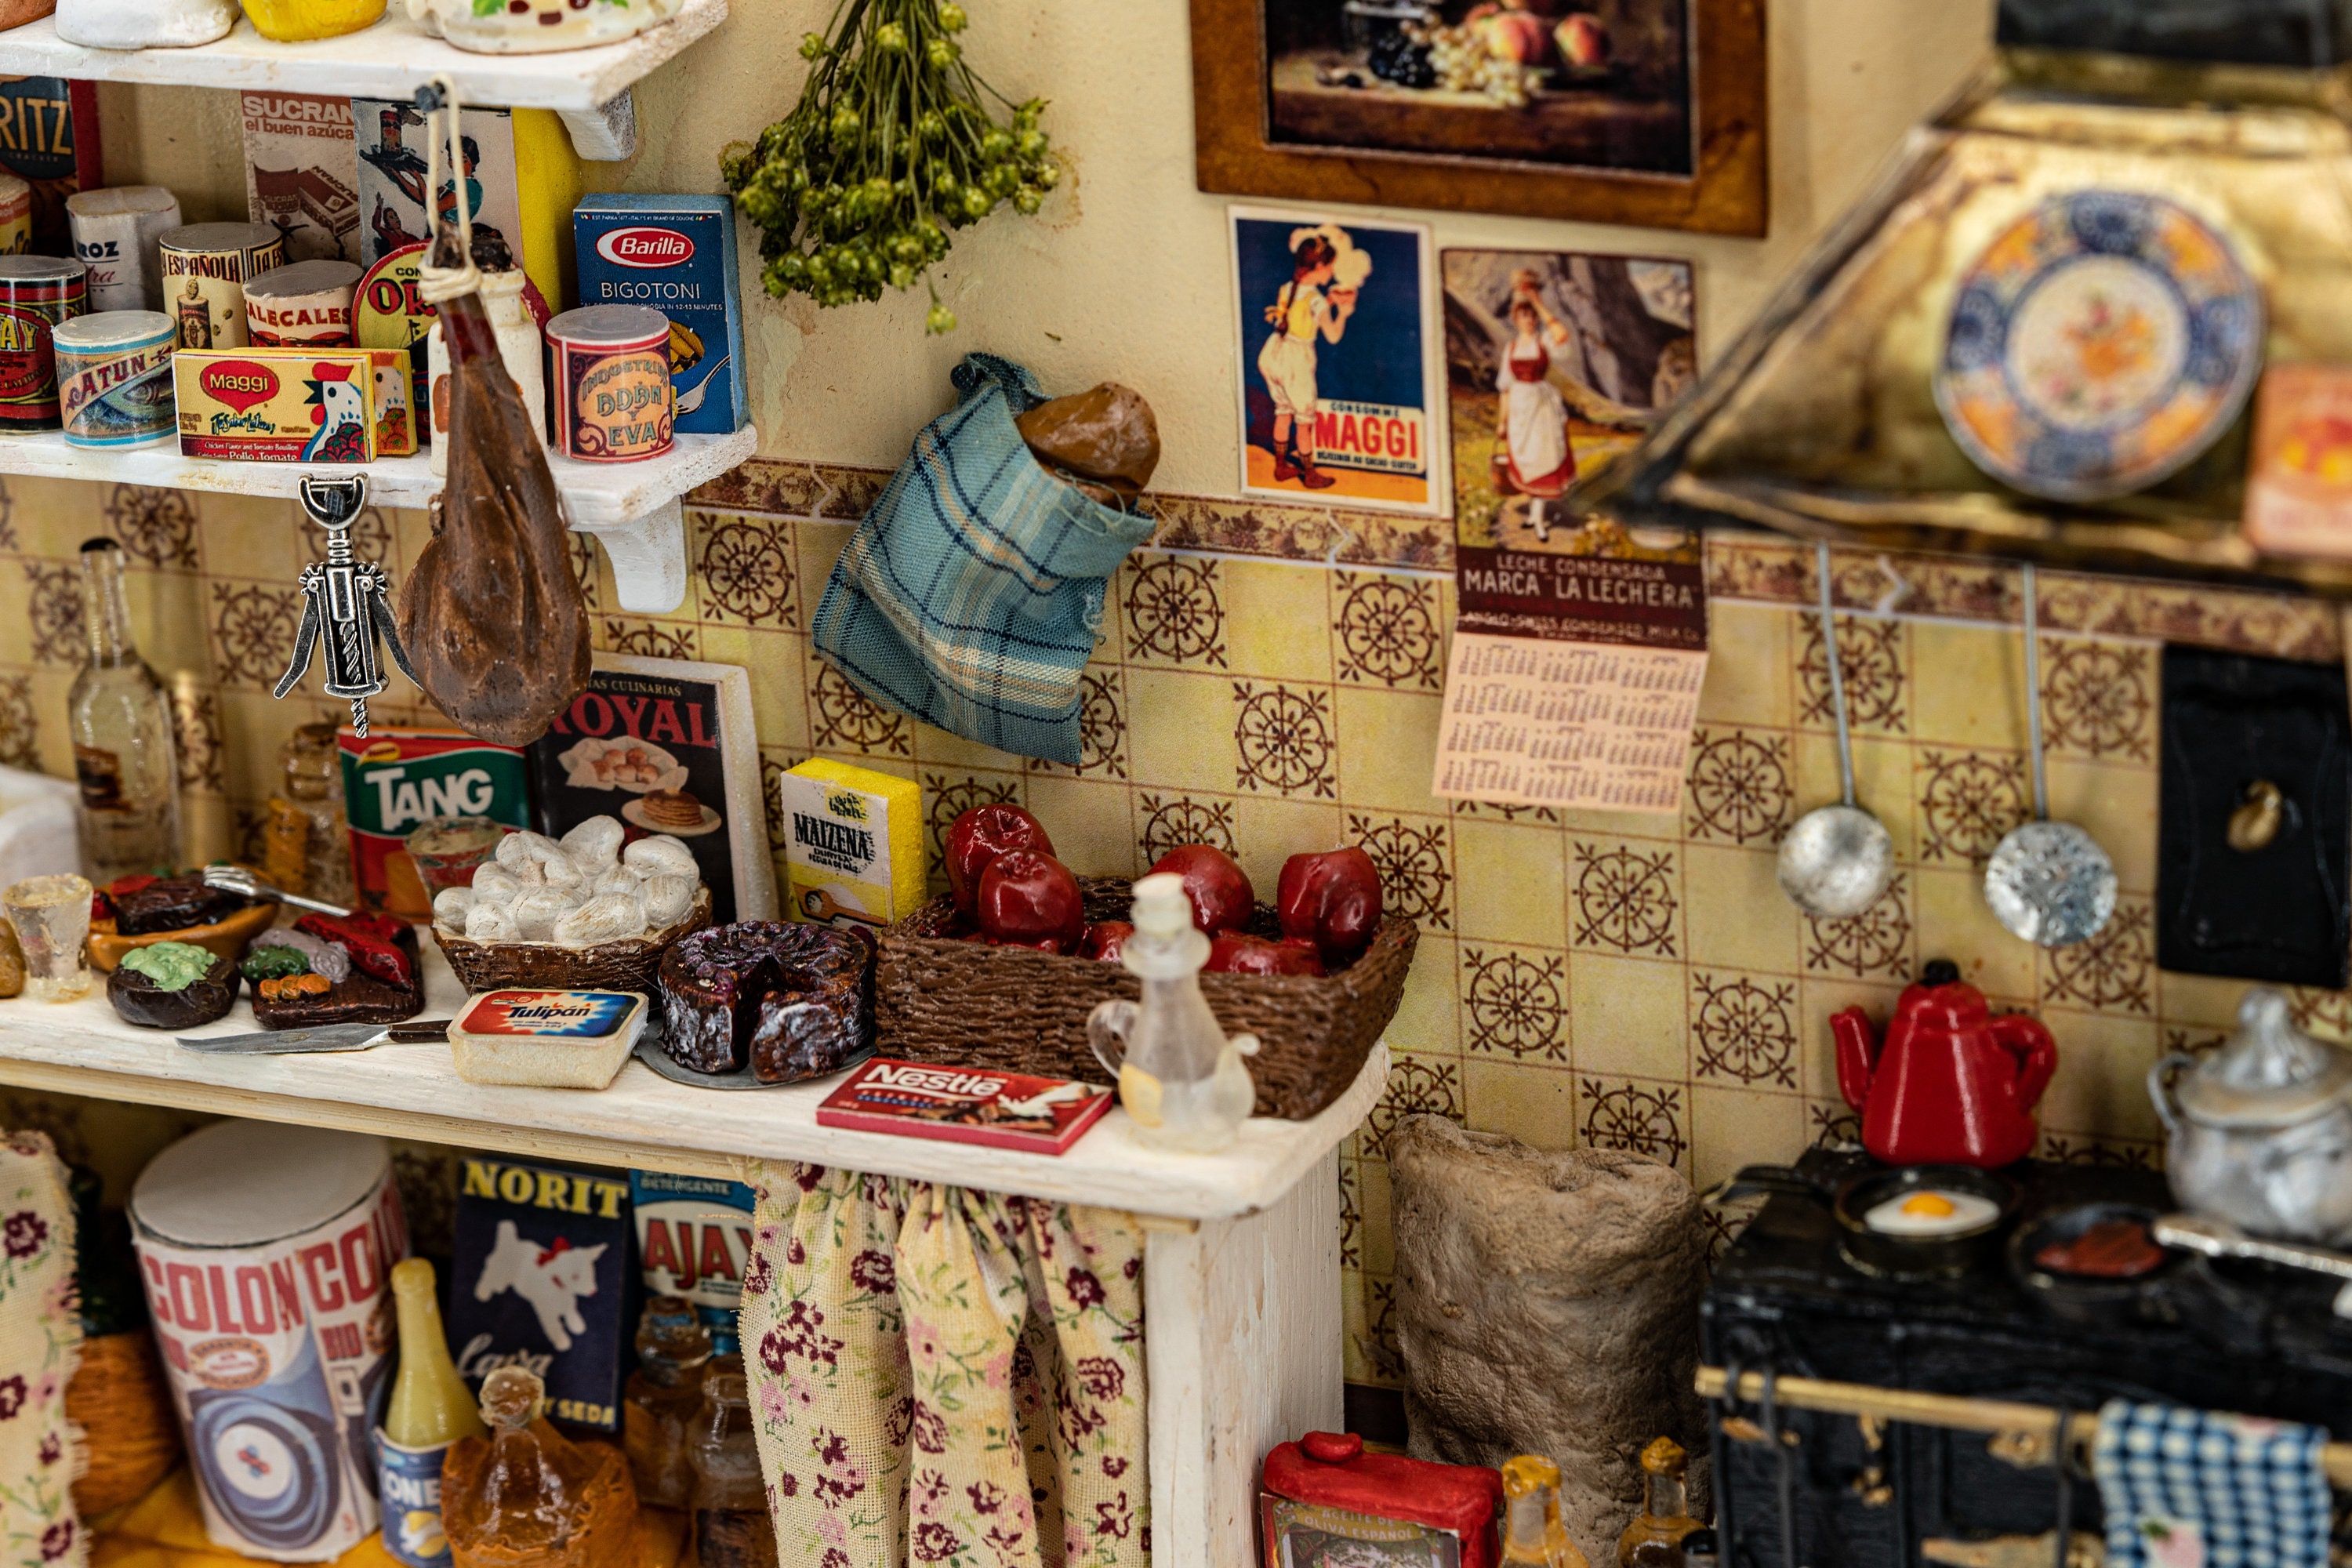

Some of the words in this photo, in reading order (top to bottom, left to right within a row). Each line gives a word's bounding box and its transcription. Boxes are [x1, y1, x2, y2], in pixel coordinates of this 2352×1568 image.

[0, 96, 72, 155] RITZ
[245, 118, 260, 132] el
[263, 118, 303, 136] buen
[307, 124, 354, 140] azúca
[76, 240, 120, 259] ROZ
[619, 237, 686, 256] Barilla
[168, 253, 241, 284] ESPAÑOLA
[601, 281, 701, 299] BIGOTONI
[693, 303, 723, 311] MINUTES
[79, 353, 147, 401] ATUN
[209, 373, 269, 393] Maggi
[628, 409, 640, 422] Y
[608, 421, 658, 447] EVA
[1315, 410, 1418, 459] MAGGI
[229, 452, 255, 461] Pollo
[259, 452, 298, 462] Tomate
[1496, 554, 1549, 574] LECHE
[1555, 557, 1667, 582] CONDENSADA
[1464, 568, 1541, 597] MARCA
[611, 680, 682, 696] CULINARIAS
[364, 767, 494, 832] TANG
[793, 811, 872, 862] MAIZENA
[508, 1005, 590, 1020] Tulipán
[463, 1160, 628, 1220] NORIT
[557, 1399, 616, 1425] SEDA
[1304, 1515, 1347, 1536] OLIVA
[1321, 1509, 1371, 1524] ACEITE
[1377, 1516, 1394, 1527] DE
